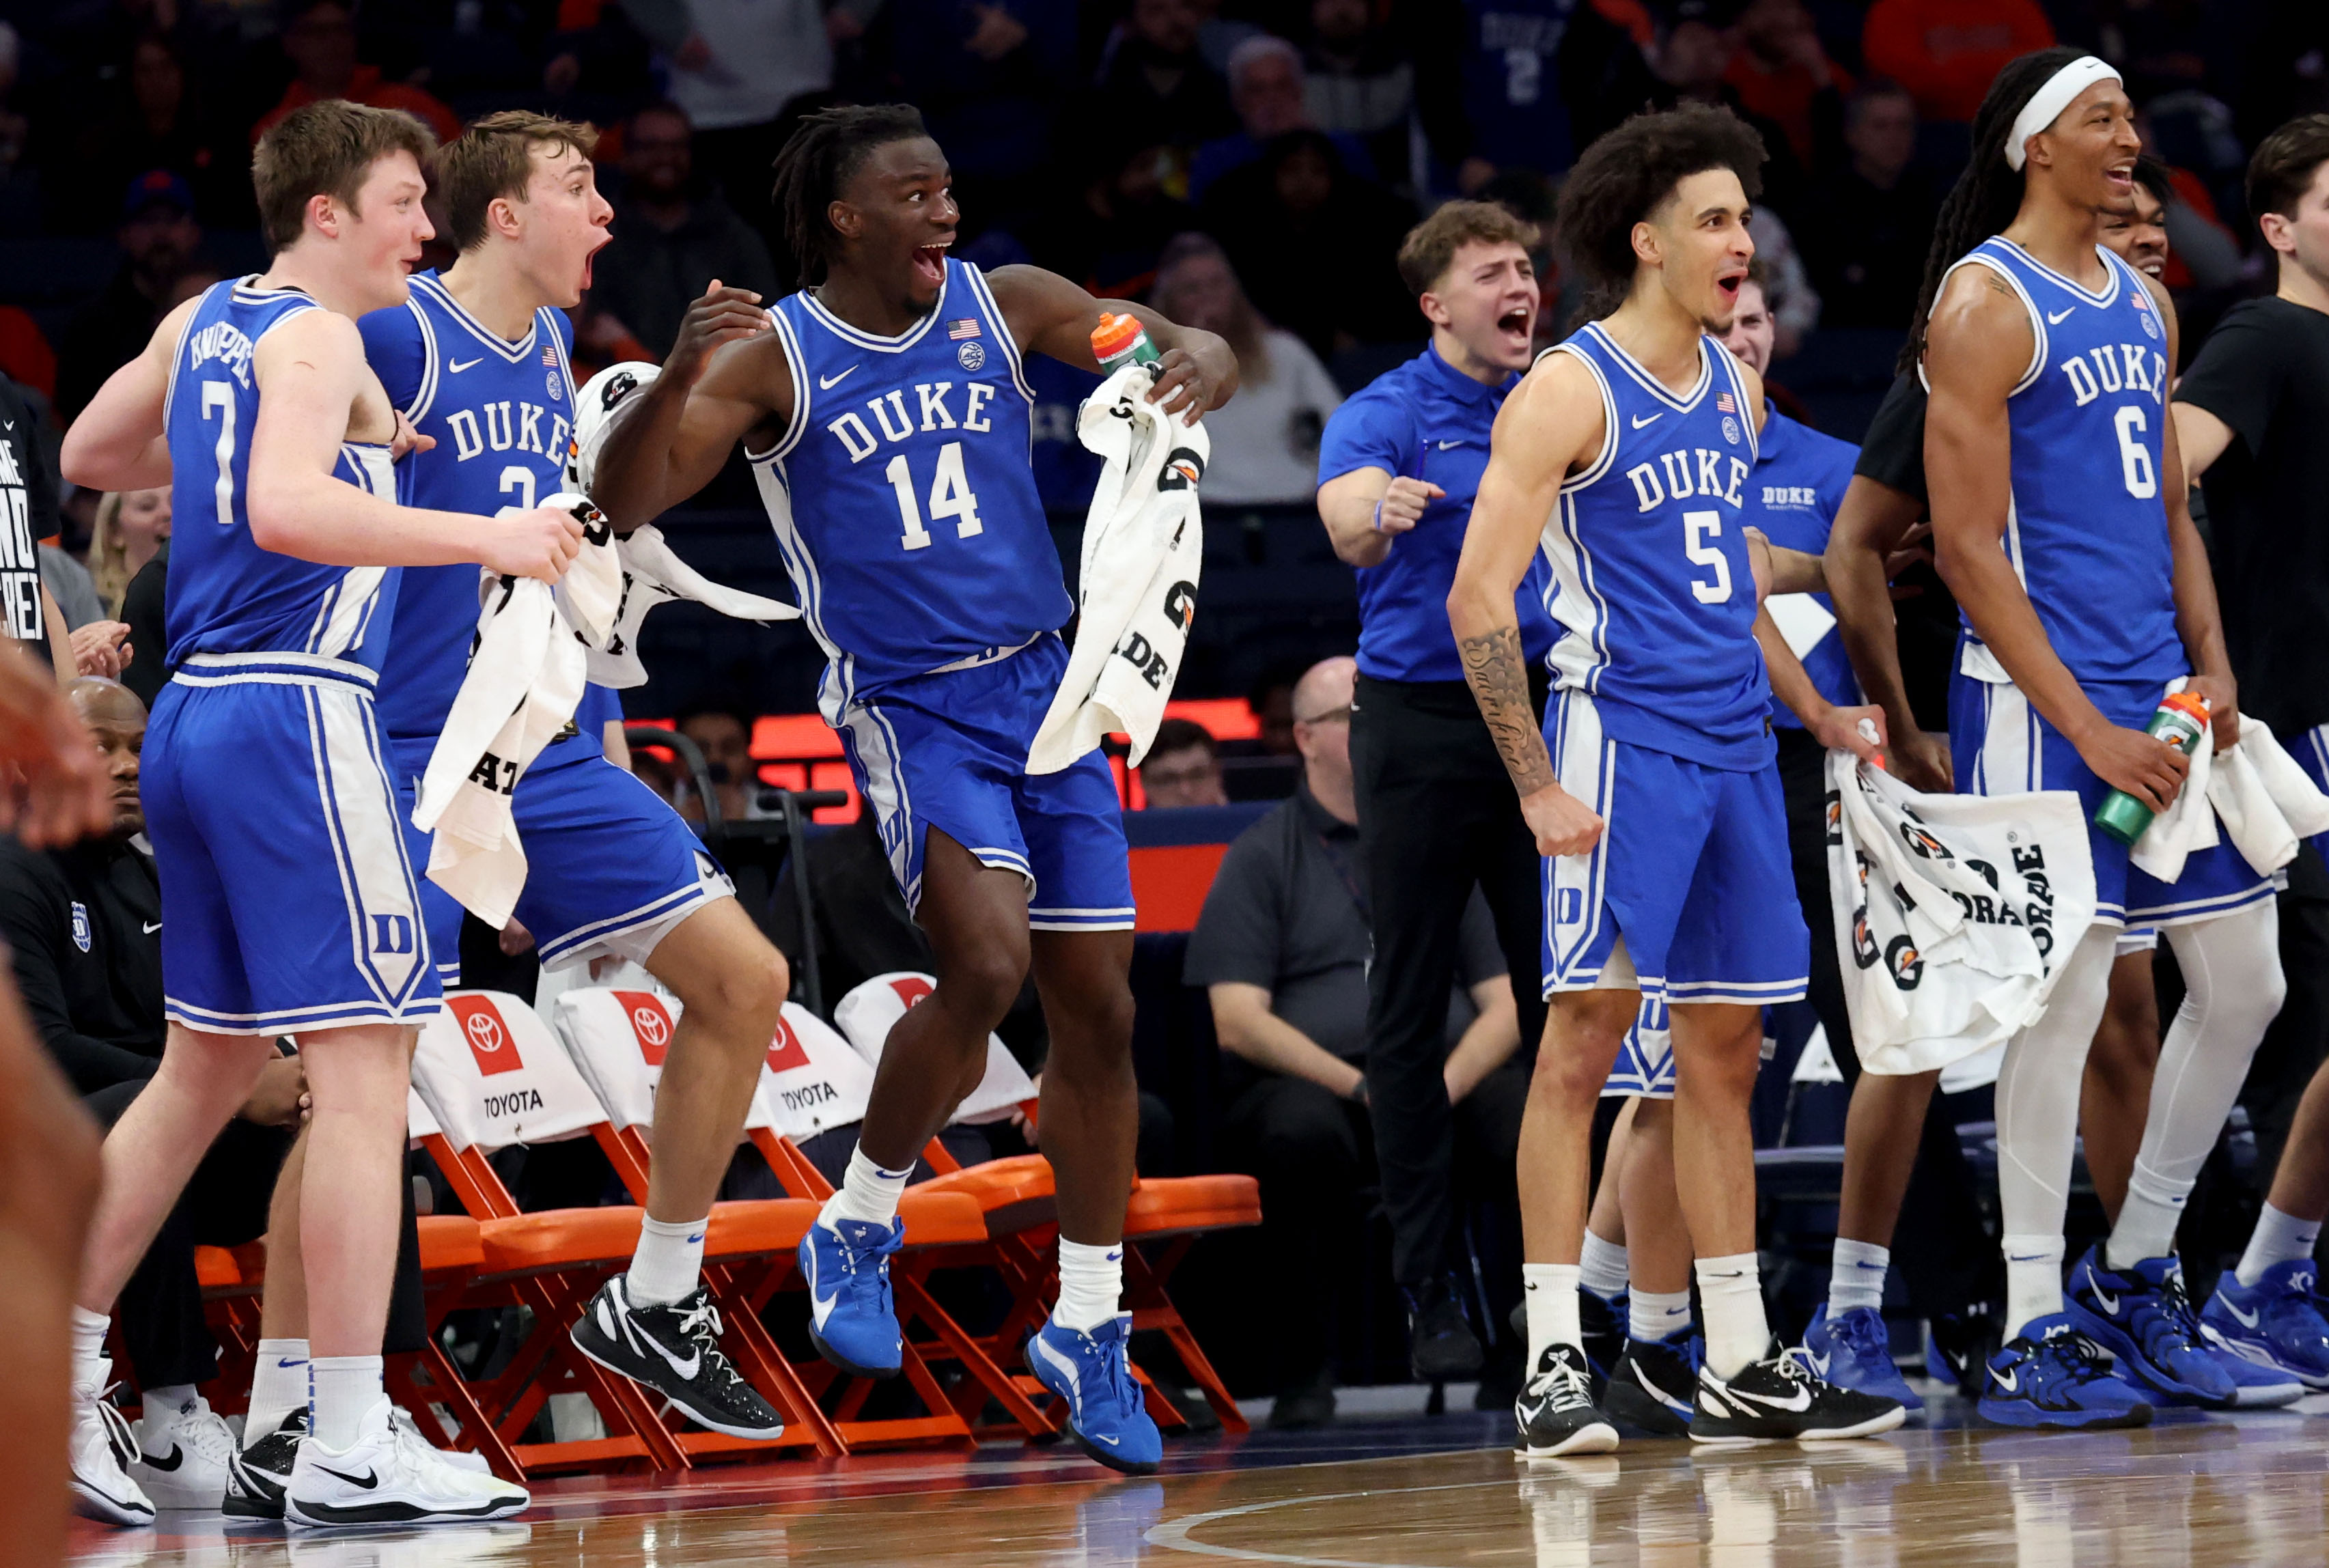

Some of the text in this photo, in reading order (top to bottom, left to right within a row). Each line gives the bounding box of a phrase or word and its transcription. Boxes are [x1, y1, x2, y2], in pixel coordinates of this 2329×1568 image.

[2061, 344, 2166, 408] DUKE
[202, 380, 236, 524] 7
[446, 401, 570, 467] DUKE
[828, 381, 994, 463] DUKE
[2115, 406, 2156, 499] 6
[887, 442, 984, 550] 14
[1627, 448, 1749, 513] DUKE
[1761, 486, 1815, 505] DUKE
[1684, 510, 1733, 604] 5
[370, 914, 413, 954] D
[1557, 888, 1582, 924] D
[484, 1089, 544, 1119] TOYOTA
[781, 1082, 838, 1112] TOYOTA
